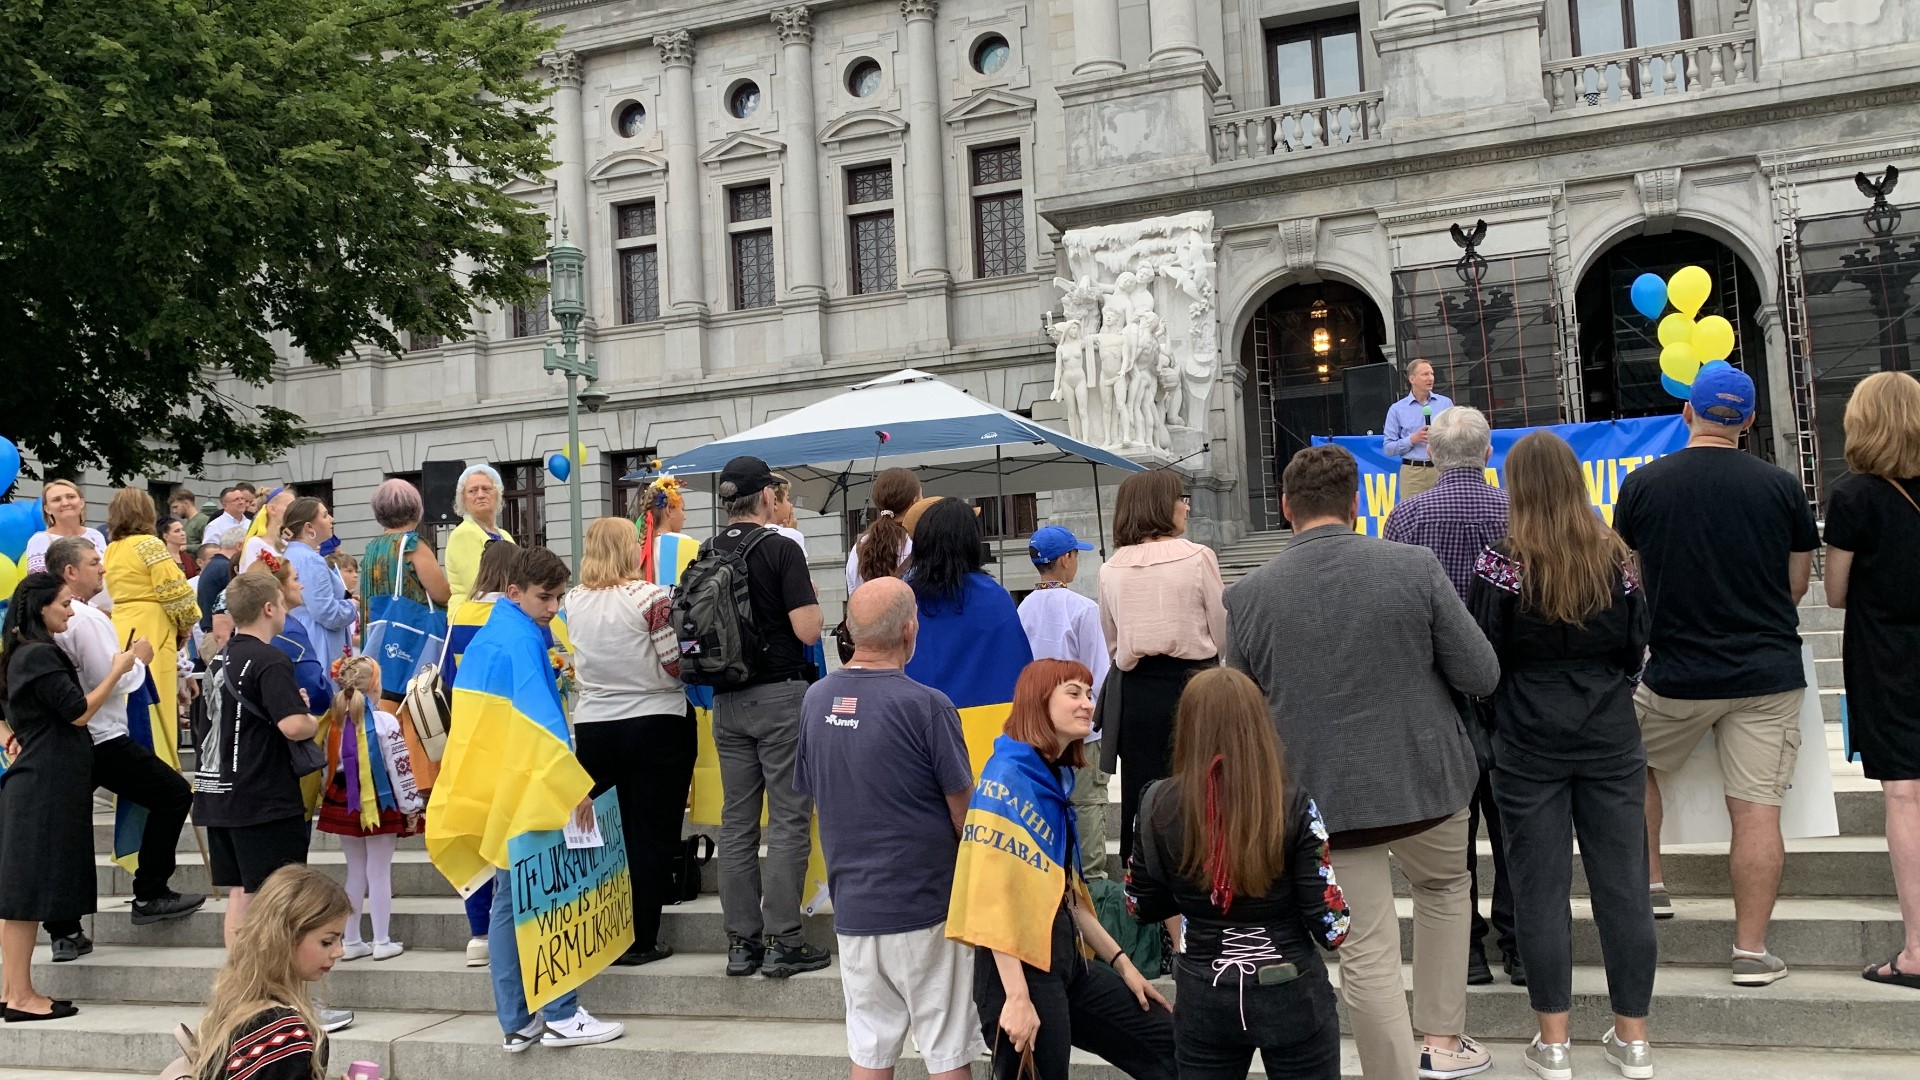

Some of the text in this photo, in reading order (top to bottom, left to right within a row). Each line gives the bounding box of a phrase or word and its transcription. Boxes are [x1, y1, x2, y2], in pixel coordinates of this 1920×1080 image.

[514, 853, 537, 915] IF
[532, 849, 626, 937] Who is NEXT?
[534, 924, 583, 997] ARM
